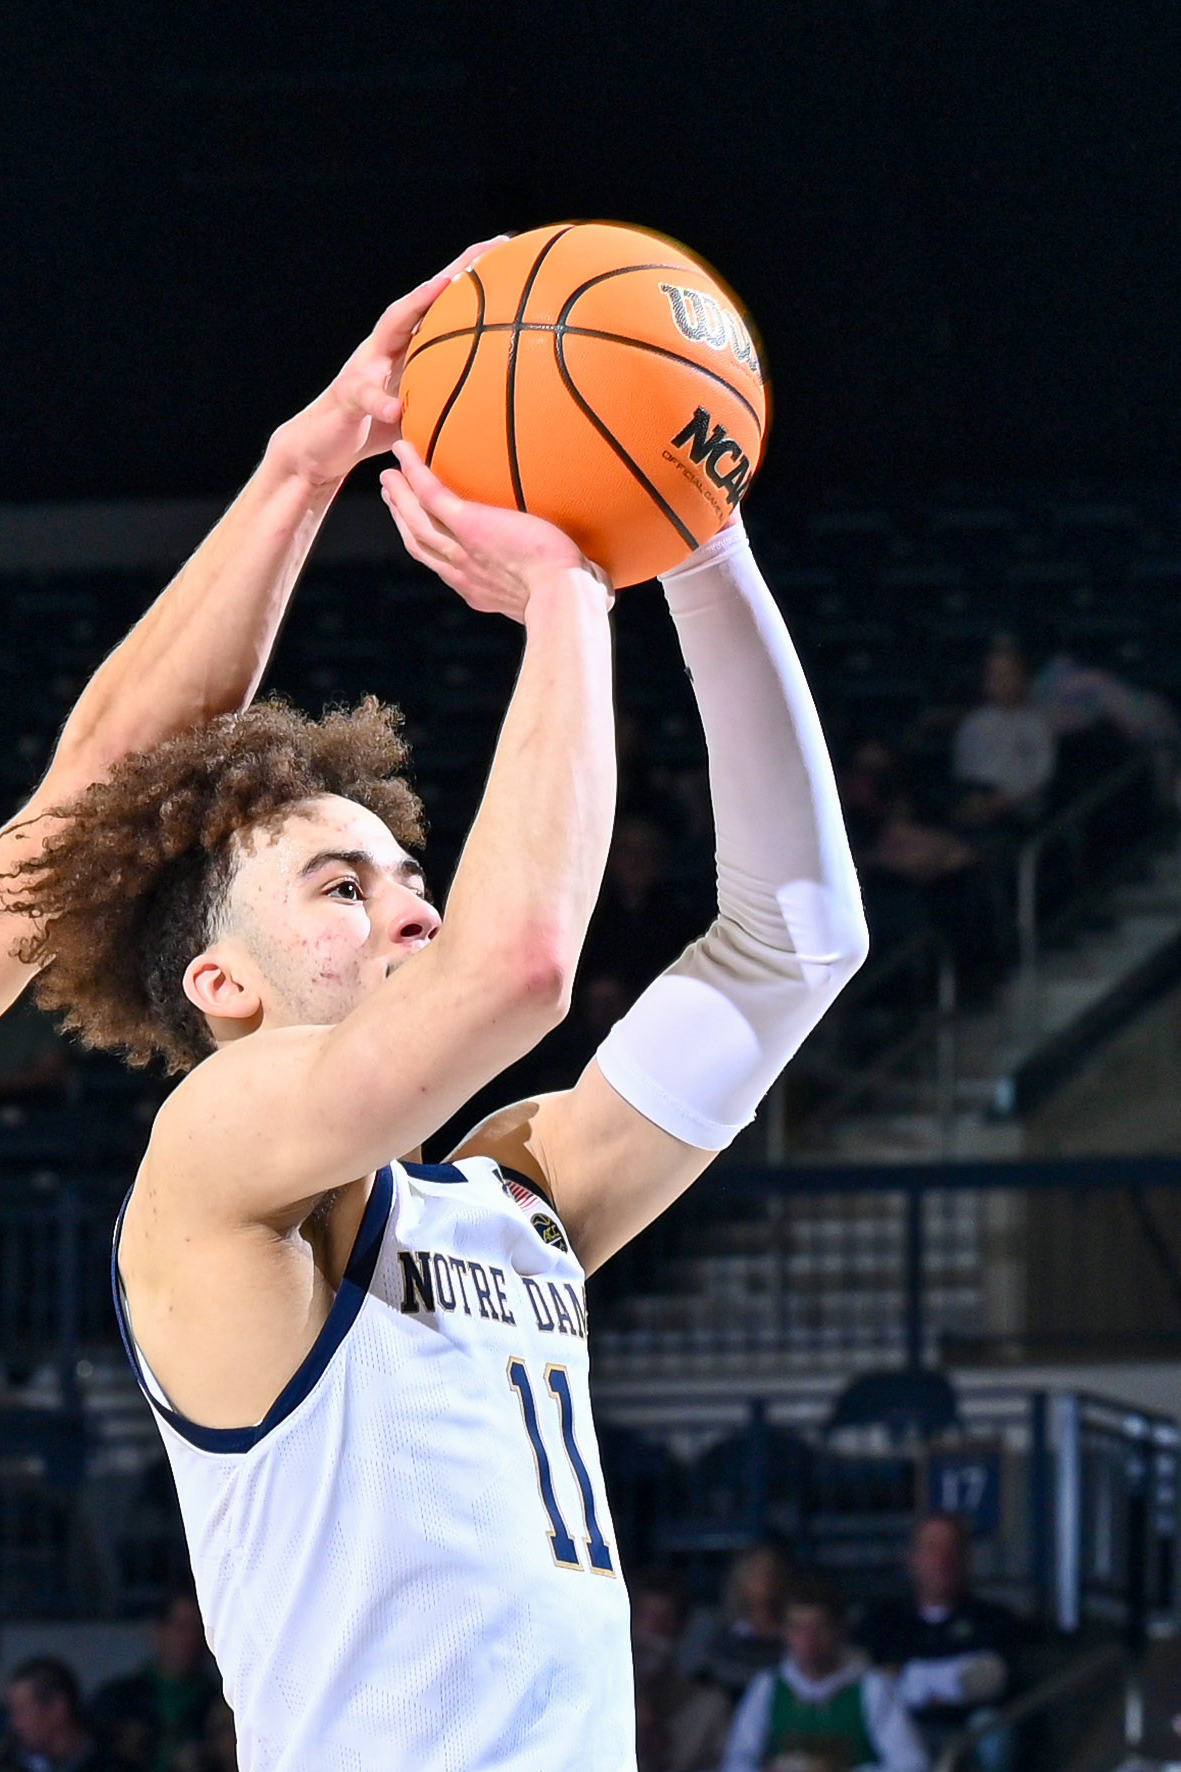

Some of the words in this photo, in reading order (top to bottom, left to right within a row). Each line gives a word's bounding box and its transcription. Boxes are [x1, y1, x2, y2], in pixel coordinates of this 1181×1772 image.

[398, 1250, 517, 1327] NOTRE
[521, 1275, 588, 1340] DAM
[506, 1355, 617, 1579] 11
